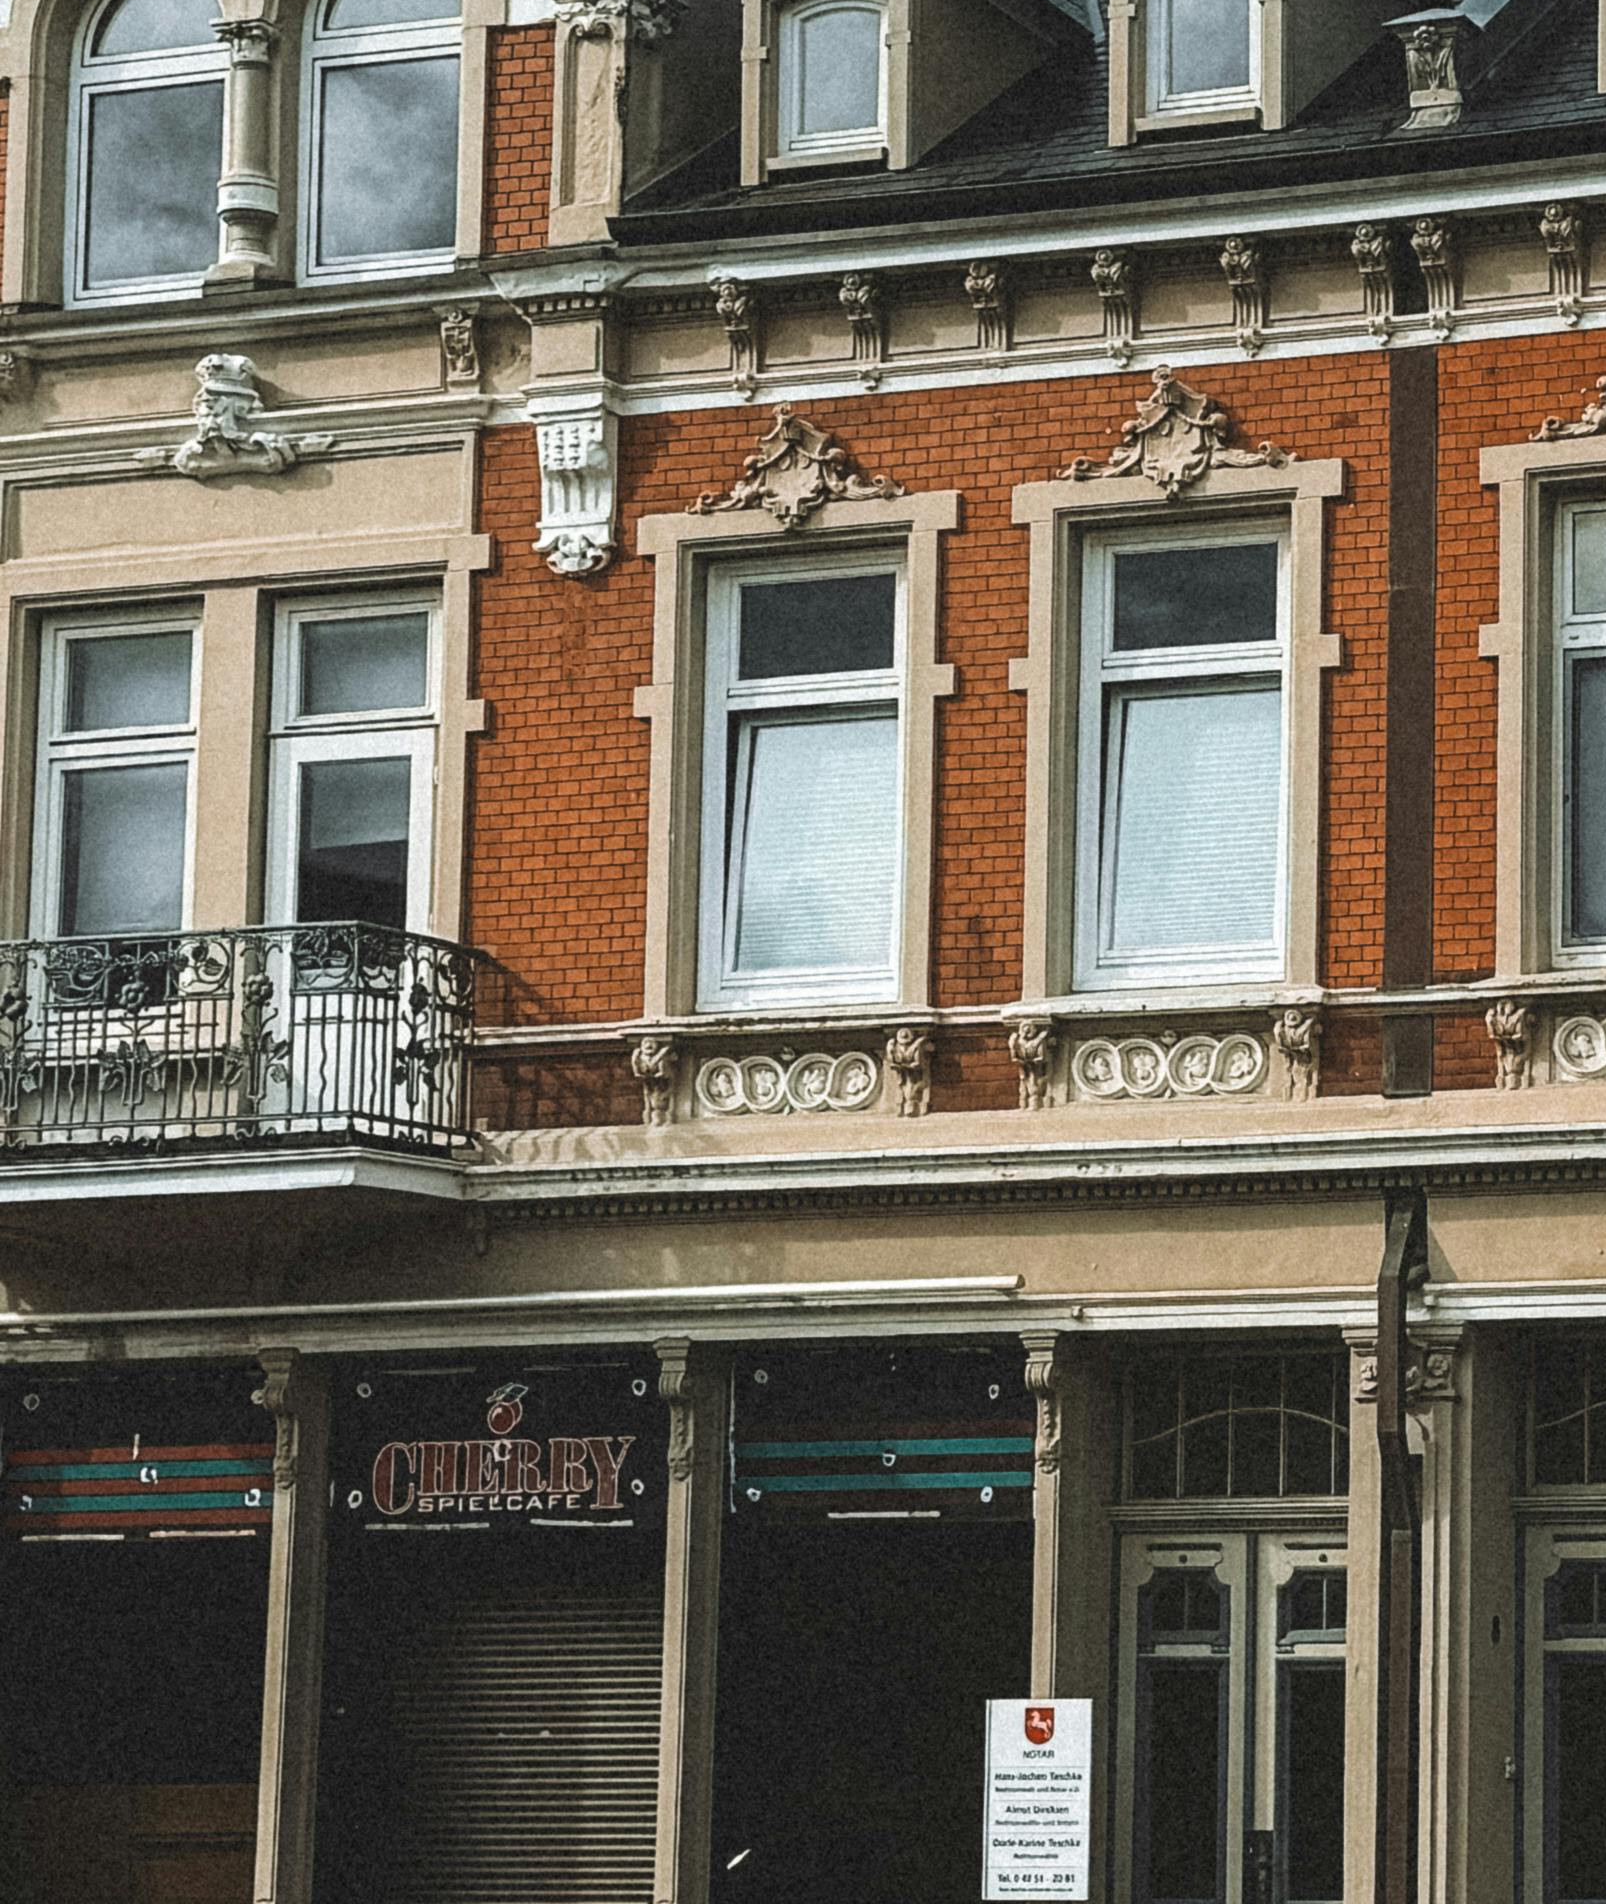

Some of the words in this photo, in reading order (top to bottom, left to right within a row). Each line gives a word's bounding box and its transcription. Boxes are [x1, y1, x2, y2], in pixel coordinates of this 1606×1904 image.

[372, 1436, 637, 1515] CHERRY
[417, 1494, 581, 1512] SPIELCAFE
[1023, 1749, 1055, 1759] NOTAR
